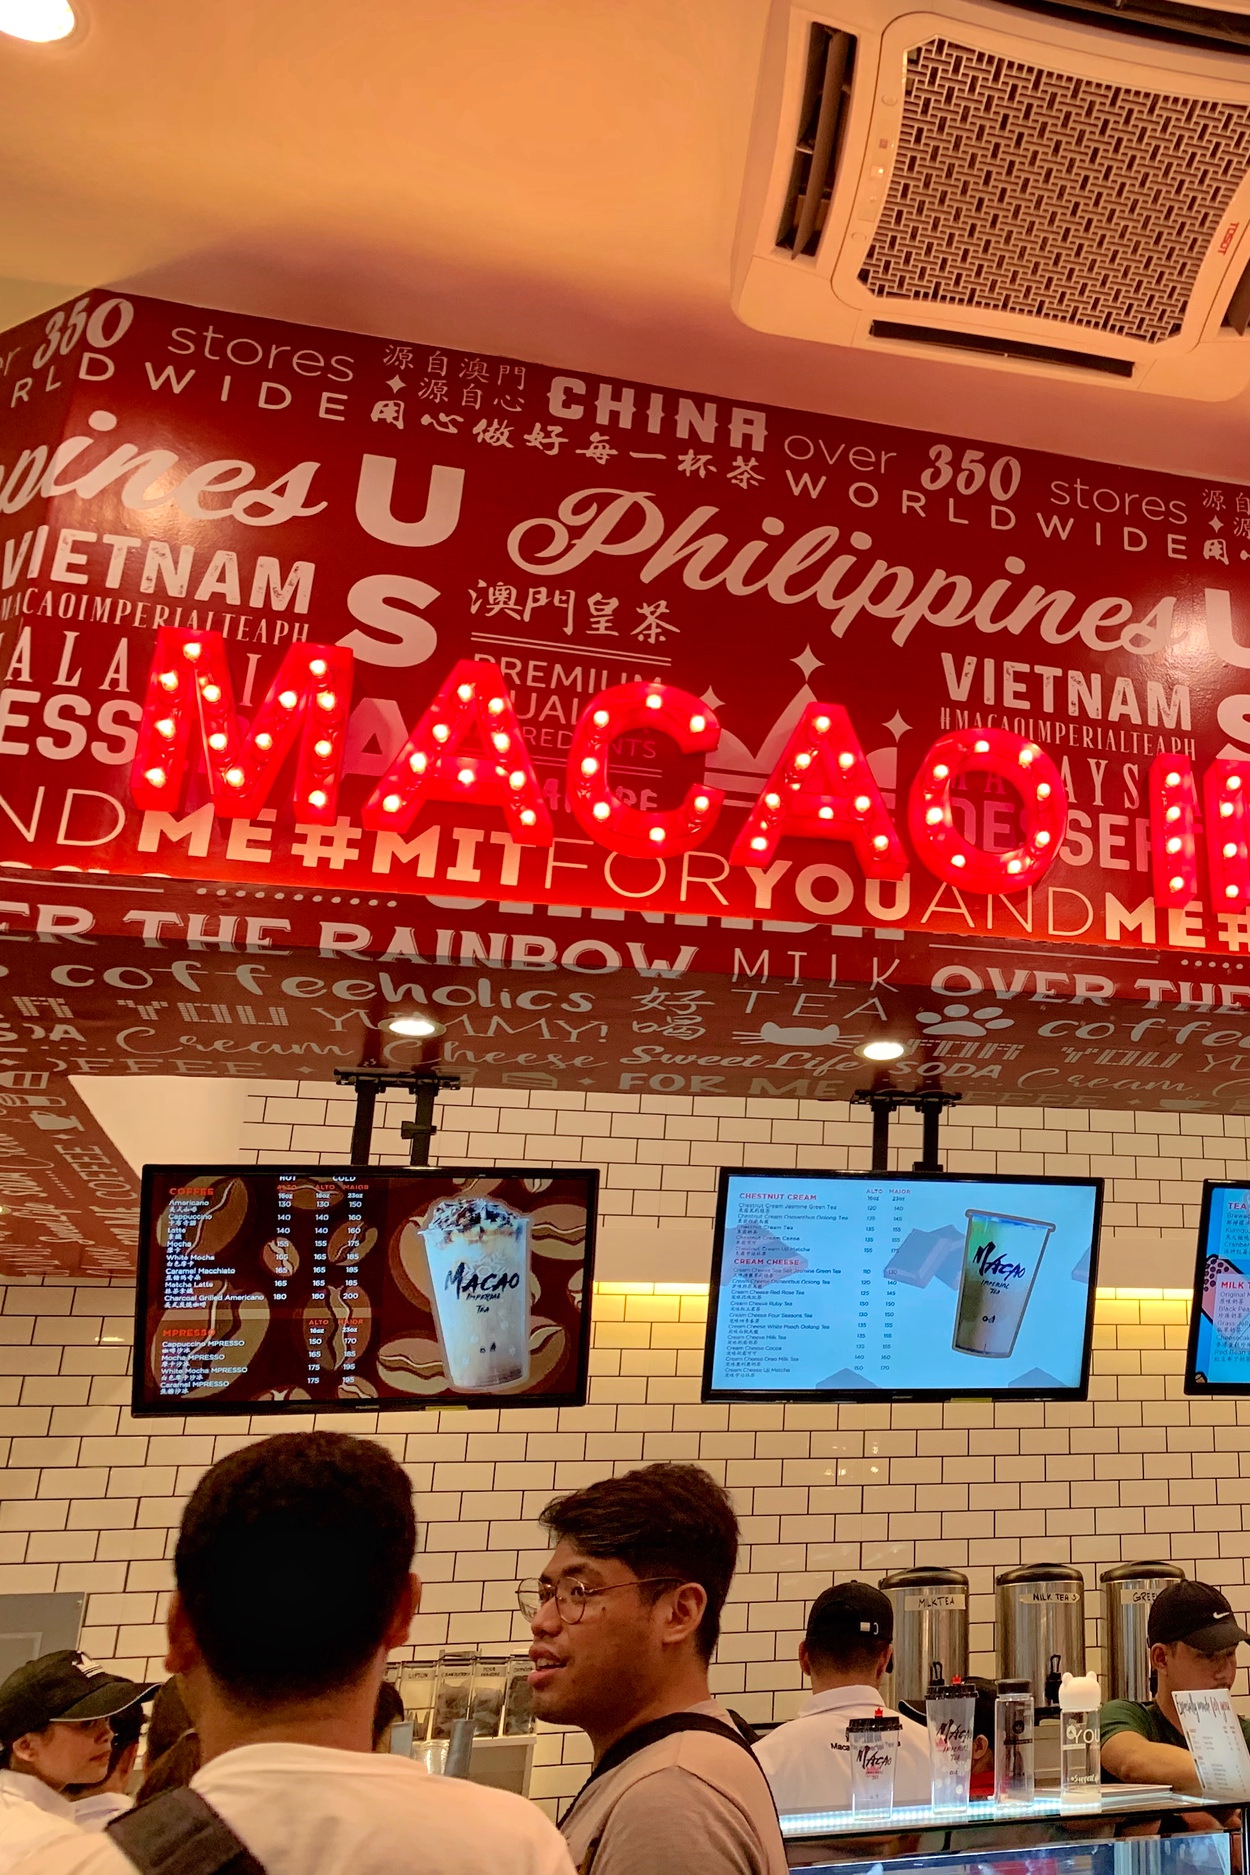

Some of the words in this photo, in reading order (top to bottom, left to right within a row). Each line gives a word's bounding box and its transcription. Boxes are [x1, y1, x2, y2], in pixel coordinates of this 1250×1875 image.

[33, 297, 134, 370] 350
[168, 326, 354, 382] stores
[383, 344, 526, 391] 源自澳門
[418, 377, 524, 413] 源自心
[546, 376, 768, 452] CHINA
[370, 398, 766, 489] 用心做好每一杯茶
[784, 434, 898, 475] over
[920, 444, 1022, 501] 350
[1050, 478, 1188, 525] stores
[786, 469, 1187, 560] WORLDWIDE
[2, 525, 316, 614] VIETNAM
[507, 488, 1187, 655] Philippines
[468, 579, 680, 644] 澳門皇茶
[941, 652, 1193, 733] VIETNAM
[130, 625, 1070, 900] MACAO
[123, 909, 293, 956] THE
[319, 921, 700, 980] RAINBOW
[51, 960, 595, 1013] coffeeholics
[731, 947, 900, 992] MILK
[930, 965, 1117, 1007] OVER
[117, 1000, 289, 1026] YOU
[731, 989, 889, 1022] TEA
[116, 1027, 354, 1054] Cream
[384, 1038, 609, 1069] Cheese
[619, 1045, 769, 1068] Sweet
[765, 1052, 870, 1077] Life
[888, 1061, 1003, 1079] SODA
[619, 1072, 727, 1093] FOR
[748, 1077, 846, 1097] ME
[739, 1192, 785, 1201] CHESTNUT
[786, 1193, 817, 1201] CREAM
[1227, 1202, 1247, 1210] TEA
[444, 1262, 520, 1300] MACAO
[1221, 1281, 1244, 1289] MILK
